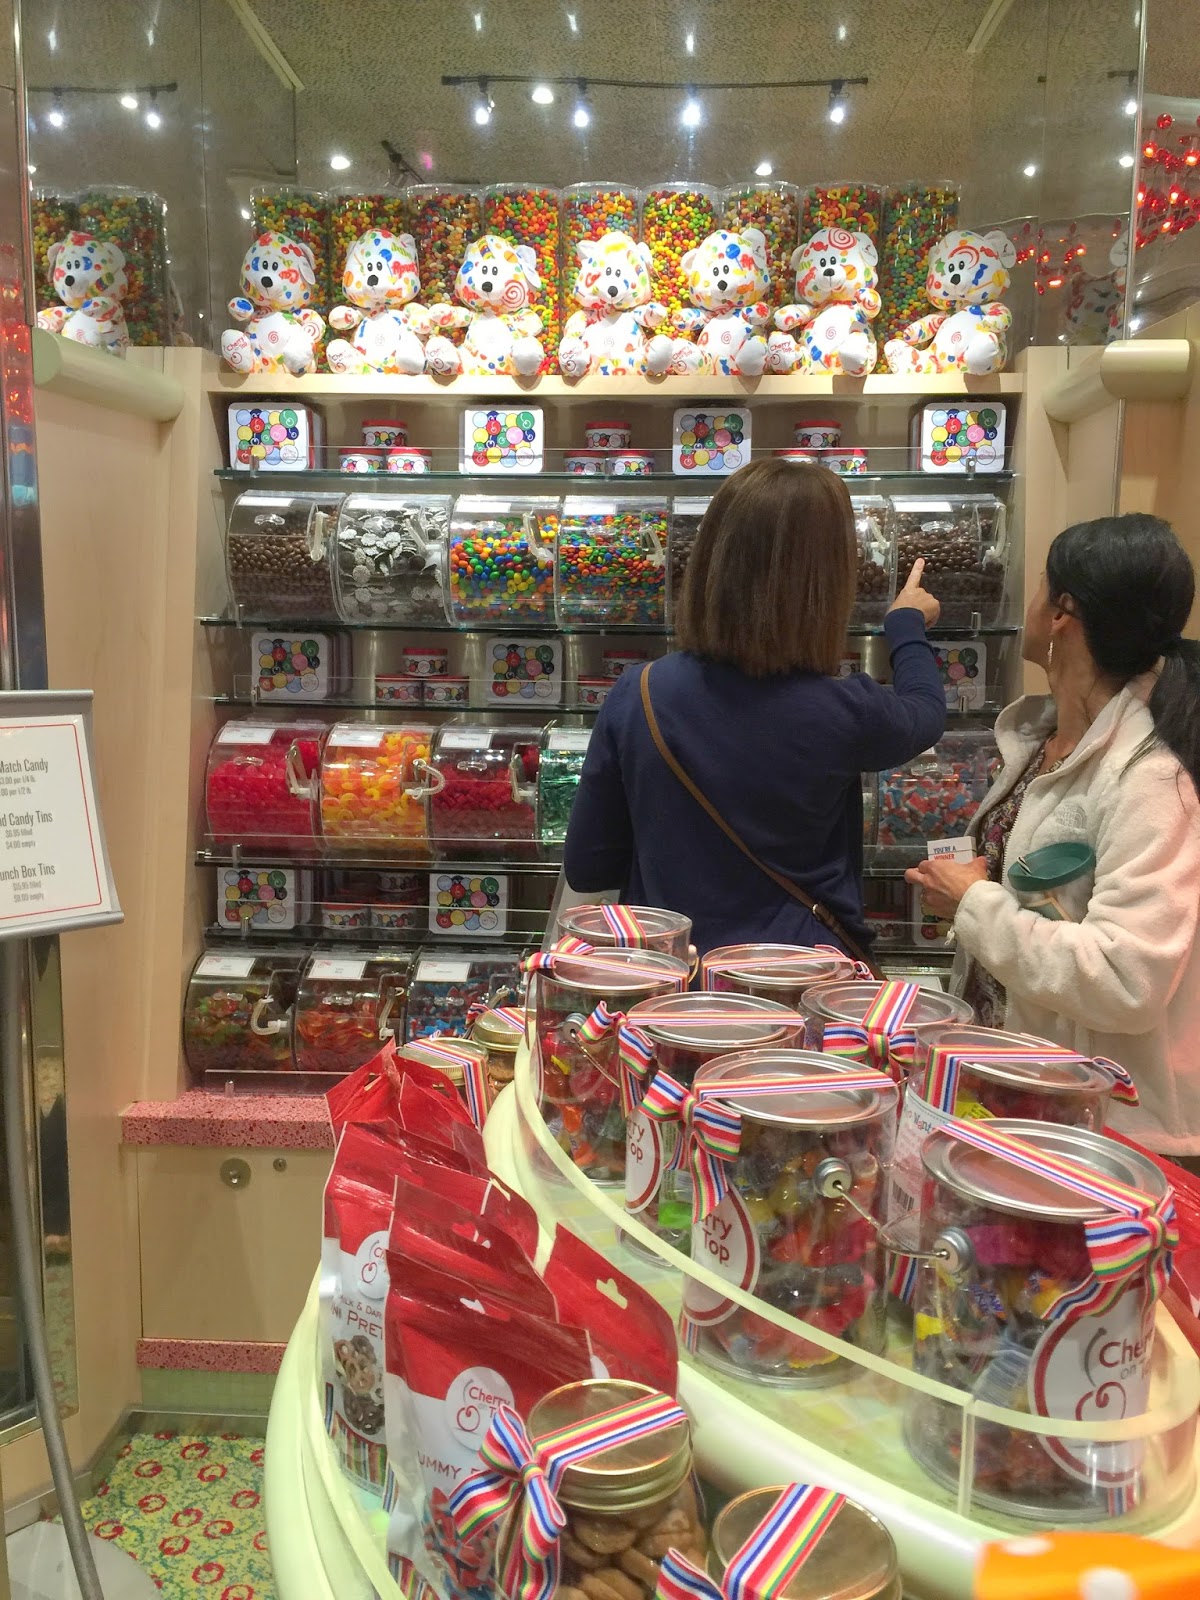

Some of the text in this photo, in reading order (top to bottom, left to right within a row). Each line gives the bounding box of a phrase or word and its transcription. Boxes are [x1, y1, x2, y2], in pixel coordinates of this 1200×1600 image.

[770, 341, 791, 351] Cherry
[24, 758, 48, 773] Candy
[0, 776, 12, 784] 3.00
[9, 811, 33, 827] Candy
[35, 810, 53, 823] Tins
[0, 863, 56, 881] unch Box Tins
[913, 1112, 934, 1135] Want
[703, 1227, 730, 1265] Top
[356, 1301, 364, 1312] &
[366, 1305, 382, 1319] DAR
[347, 1309, 383, 1340] PRET
[417, 1450, 461, 1480] UMMY
